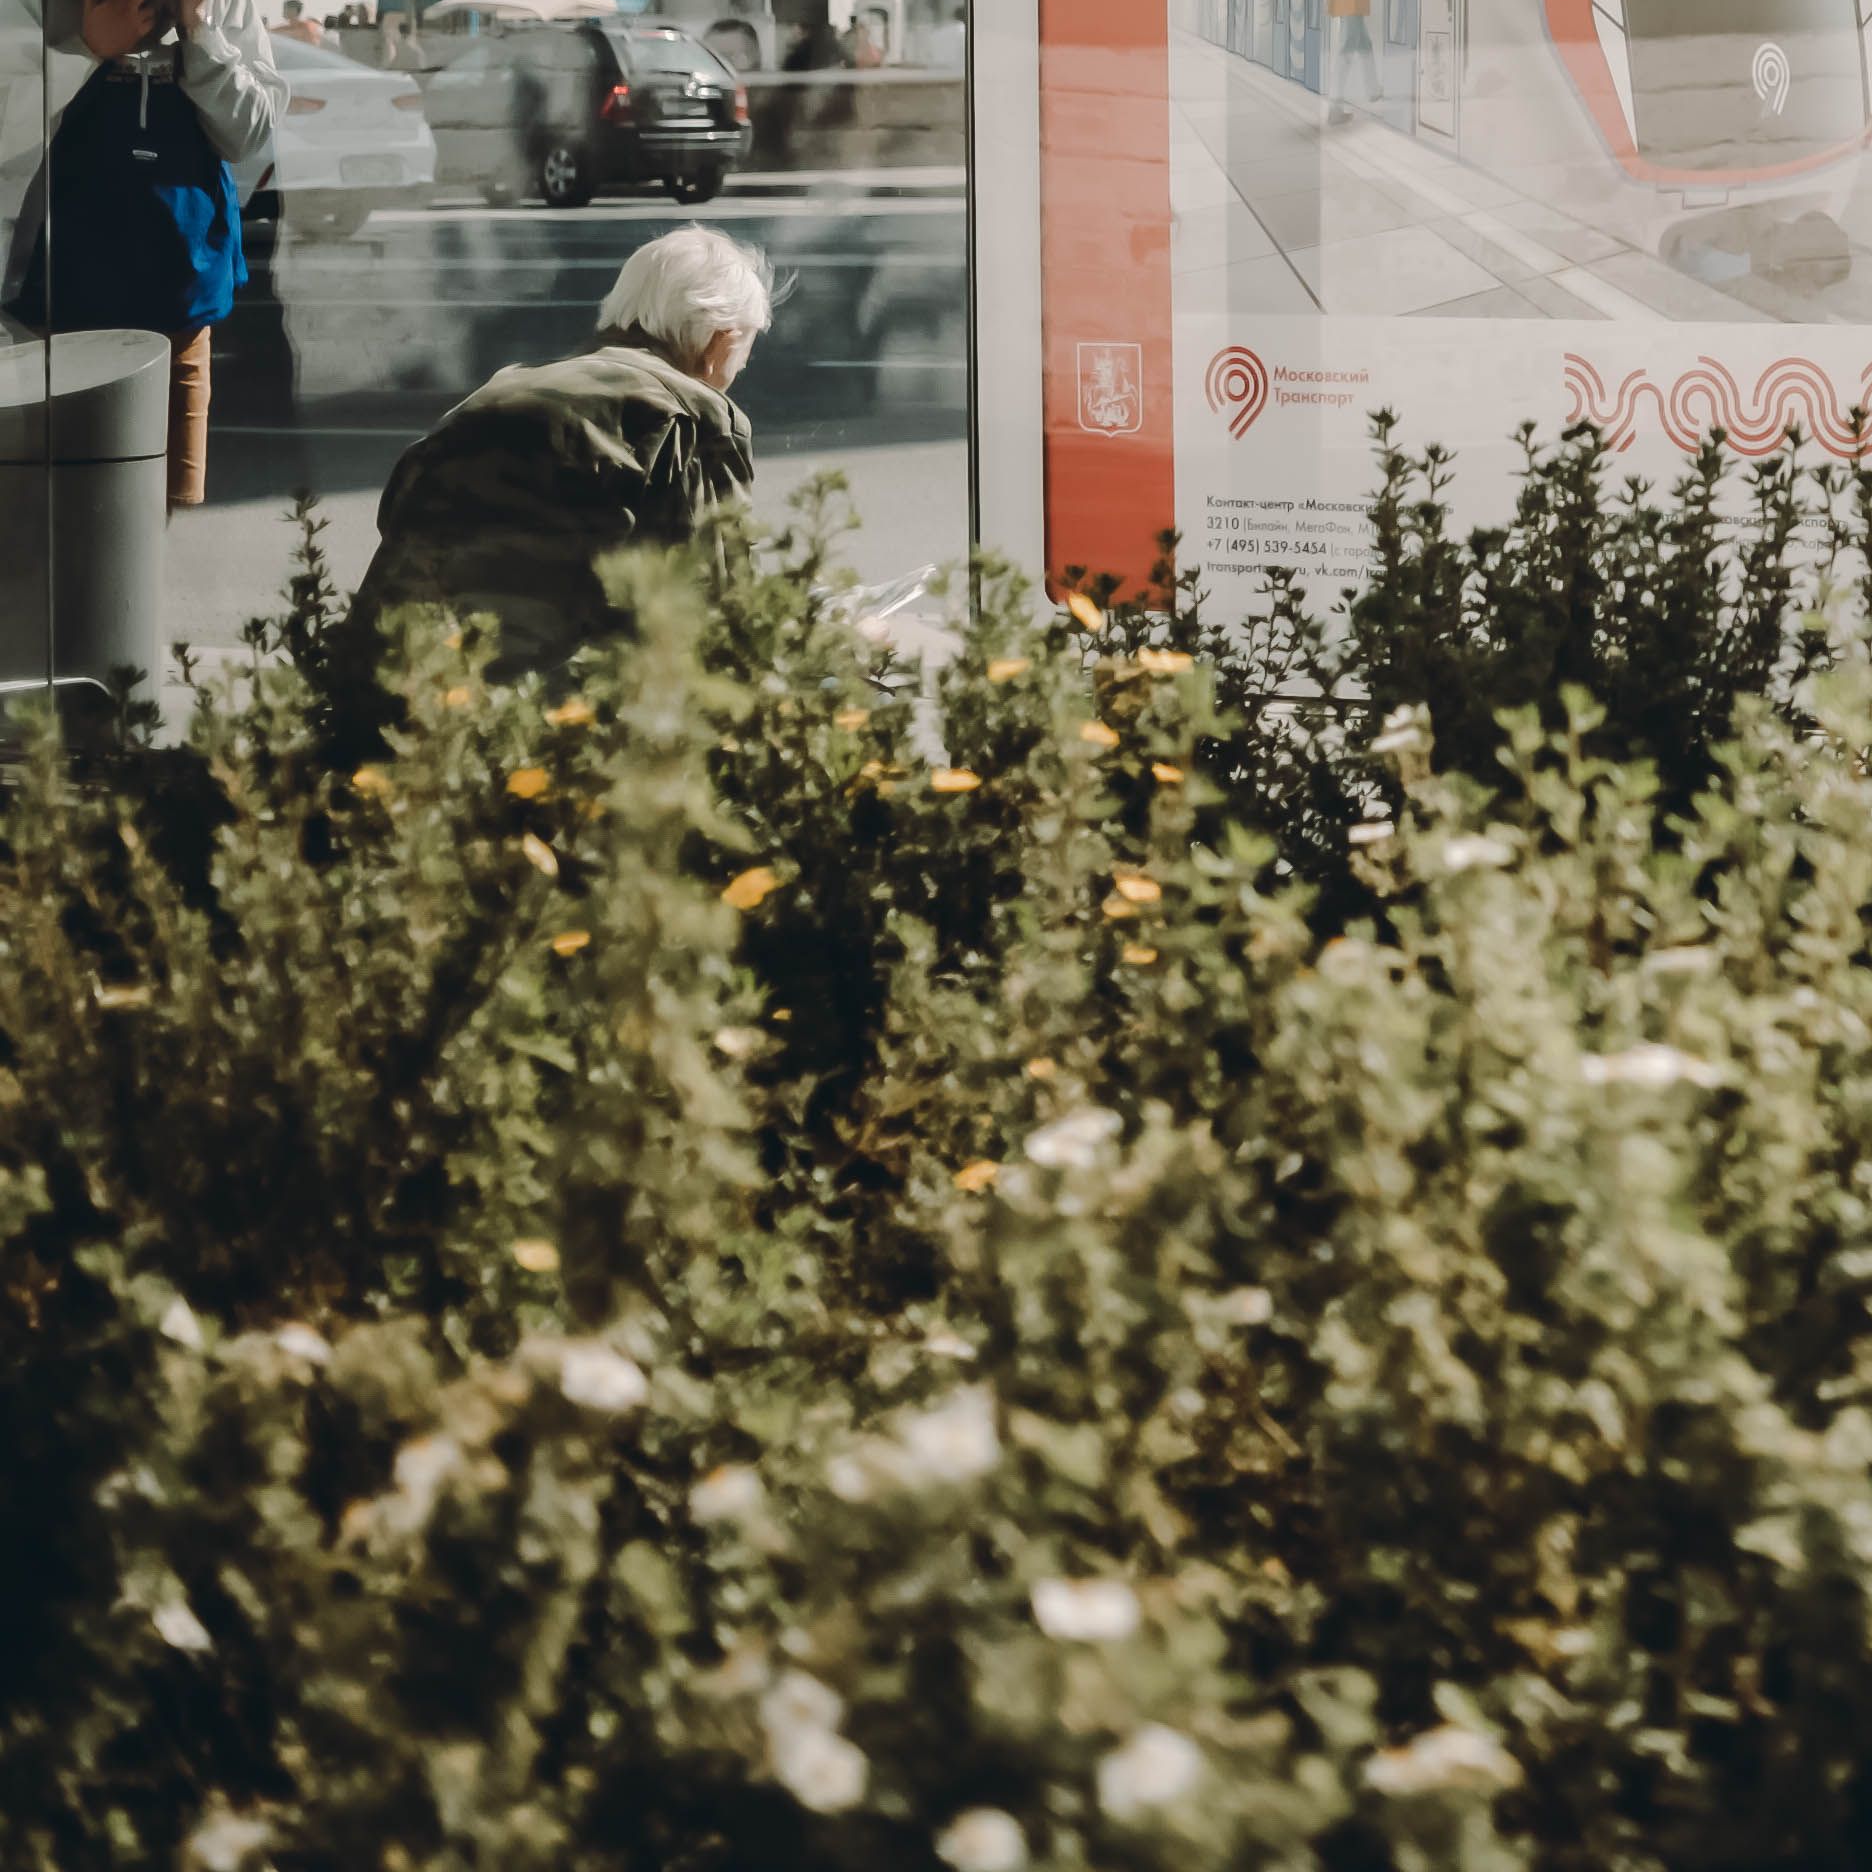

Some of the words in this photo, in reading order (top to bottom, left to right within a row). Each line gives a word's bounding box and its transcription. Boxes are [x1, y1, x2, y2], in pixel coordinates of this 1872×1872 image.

[1273, 365, 1370, 385] Московский
[1273, 386, 1355, 409] Транспорт
[1206, 495, 1295, 513] Контакт-центр
[1206, 515, 1241, 531] 3210
[1207, 538, 1223, 552] +7
[1225, 537, 1261, 556] (495)
[1264, 539, 1327, 555] 539-5454
